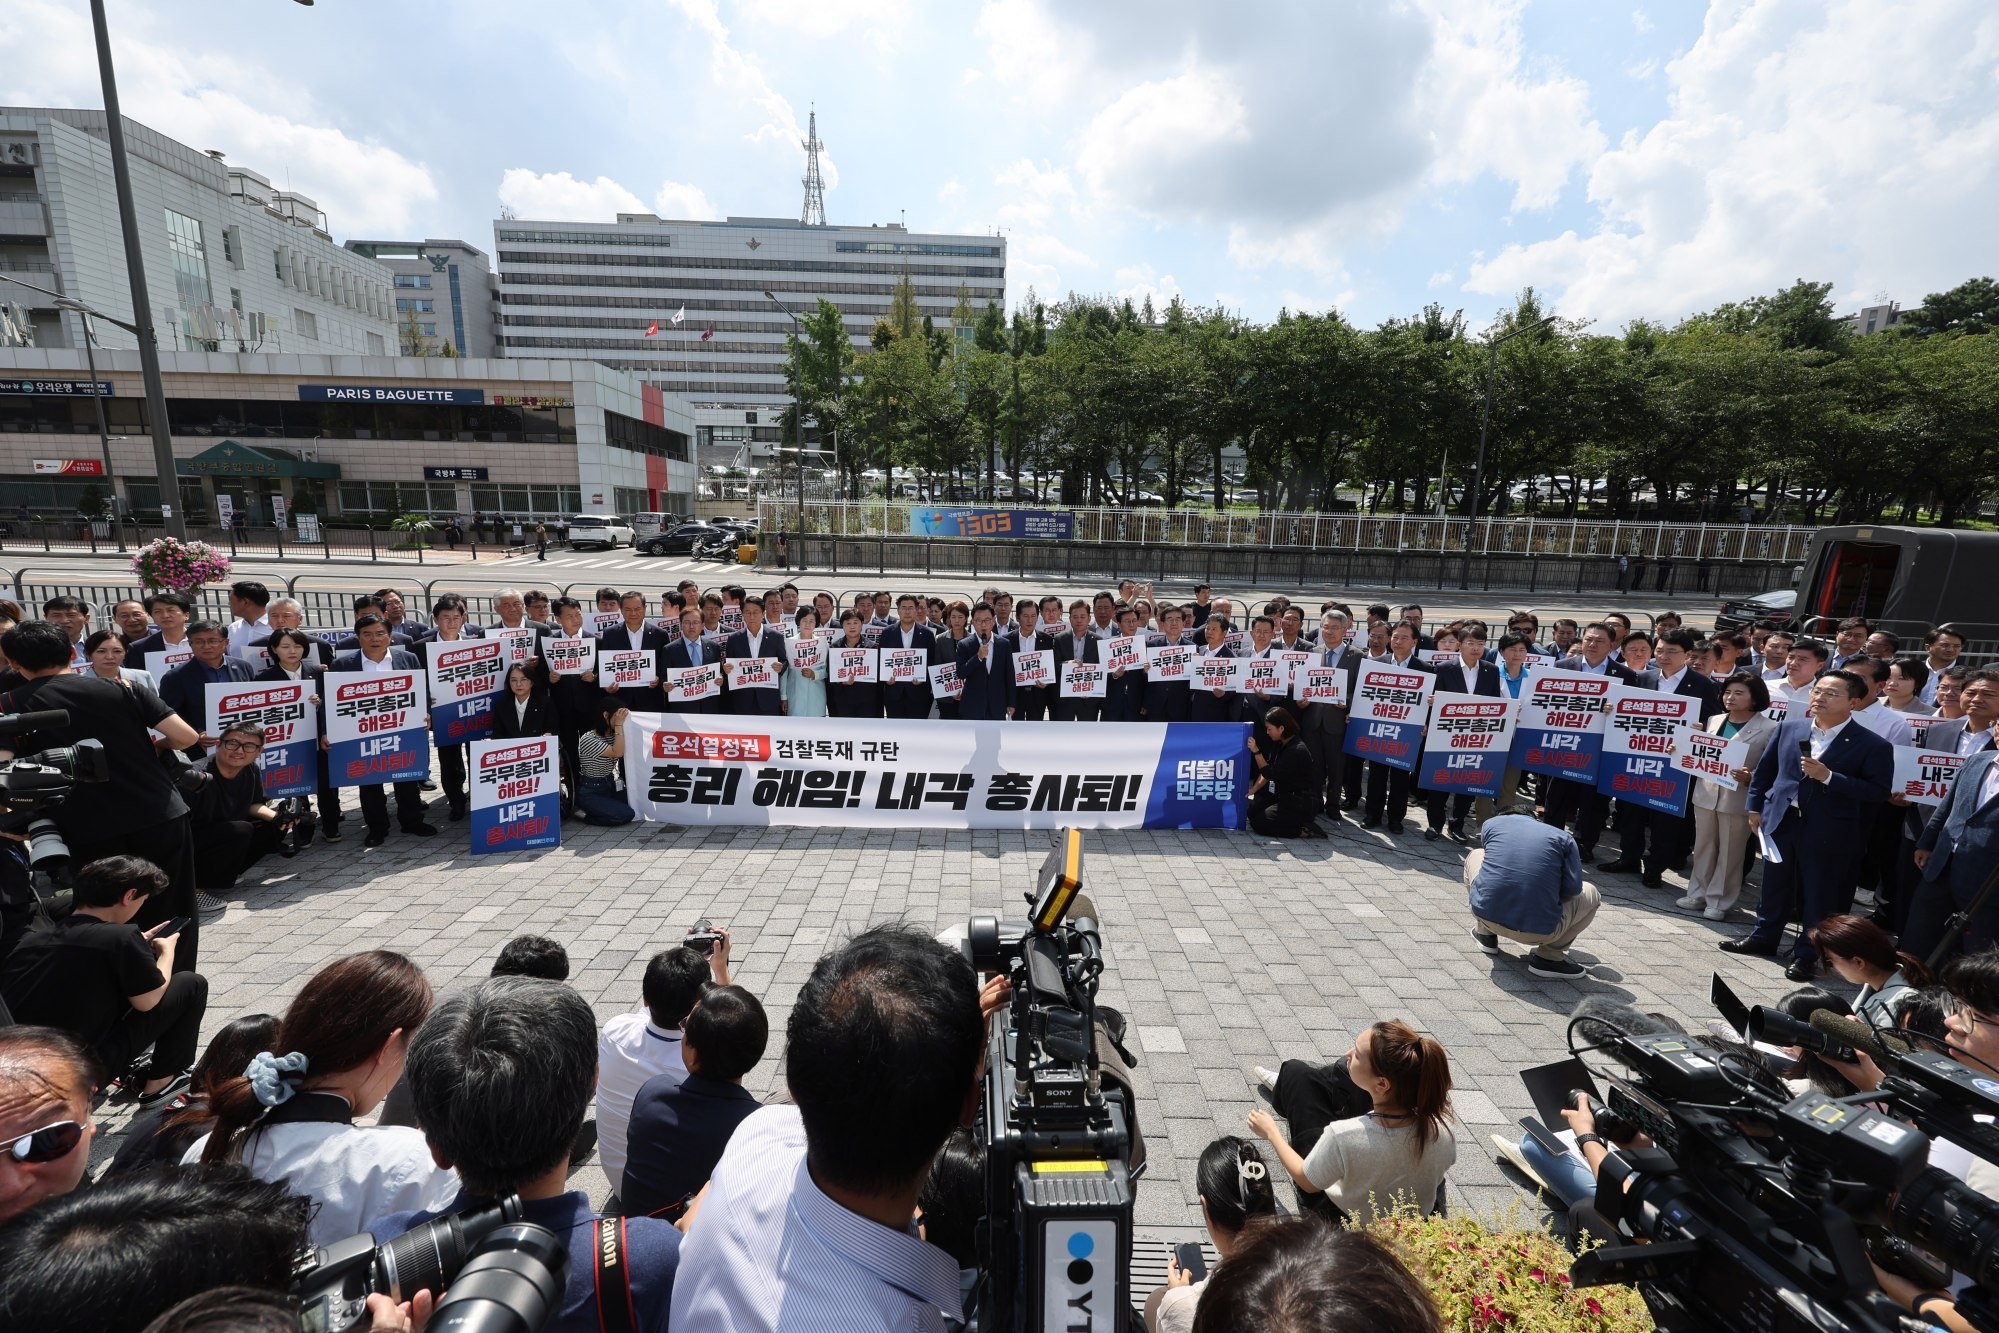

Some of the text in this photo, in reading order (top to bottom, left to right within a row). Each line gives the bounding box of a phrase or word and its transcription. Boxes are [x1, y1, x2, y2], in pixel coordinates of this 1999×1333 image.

[36, 382, 73, 393] 우리은행
[327, 389, 453, 400] PARIS BAGUETTE
[957, 513, 1011, 536] 1303
[476, 646, 495, 657] 정권
[546, 646, 590, 660] 국무총리
[798, 647, 817, 658] 내각
[1113, 645, 1132, 658] 내각
[554, 658, 581, 670] 해임!
[605, 658, 650, 672] 국무총리
[844, 657, 863, 667] 내각
[885, 656, 922, 668] 국무총리
[1022, 660, 1040, 671] 내각
[1108, 653, 1139, 669] 총사퇴!
[1153, 653, 1191, 668] 국무총리
[438, 657, 503, 682] 국무총리
[615, 670, 641, 682] 해임!
[742, 665, 763, 675] 내각
[838, 666, 869, 678] 총사퇴!
[893, 666, 914, 677] 해임!
[1016, 668, 1047, 682] 총사퇴!
[1161, 666, 1184, 676] 해임!
[1195, 665, 1236, 676] 국무총리
[1252, 668, 1274, 678] 내각
[674, 671, 715, 689] 국무총리
[737, 673, 770, 685] 총사퇴!
[1066, 671, 1102, 683] 국무총리
[1204, 676, 1227, 686] 해임!
[1245, 678, 1279, 689] 총사퇴!
[1310, 677, 1332, 687] 내각
[1399, 676, 1418, 686] 정권
[383, 679, 406, 690] 정권
[456, 675, 495, 696] 해임!
[684, 684, 707, 697] 해임!
[1073, 682, 1094, 692] 해임!
[1578, 682, 1601, 692] 정권
[269, 689, 295, 702] 정권
[1302, 687, 1338, 697] 총사퇴!
[1361, 686, 1423, 705] 국무총리
[336, 692, 415, 717] 국무총리
[458, 697, 492, 718] 내각
[1480, 705, 1500, 714] 정권
[1531, 694, 1607, 713] 국무총리
[1657, 703, 1680, 714] 정권
[1373, 703, 1411, 720] 해임!
[358, 711, 406, 733] 해임!
[1437, 718, 1506, 732] 국무총리
[1546, 711, 1593, 728] 해임!
[264, 723, 294, 743] 임!
[1368, 723, 1401, 740] 내각
[360, 735, 401, 757] 내각
[1356, 737, 1410, 756] 총사퇴!
[1451, 734, 1493, 748] 해임!
[1541, 733, 1581, 750] 내각
[520, 745, 540, 757] 정권
[776, 740, 854, 760] 검찰독재
[860, 741, 899, 761] 규탄
[1692, 744, 1722, 761] 내각
[347, 750, 416, 778] 총사퇴!
[1447, 755, 1483, 768] 내각
[1525, 749, 1592, 768] 총사퇴!
[480, 758, 549, 783] 국무총리
[1176, 760, 1234, 780] 더불어
[1626, 757, 1664, 777] 내각
[1681, 755, 1729, 777] 총사퇴!
[262, 765, 304, 788] 사퇴!
[1433, 769, 1493, 784] 총사퇴!
[498, 777, 540, 799] 해임!
[648, 764, 1143, 812] 총리 해임! 내각 총사퇴!
[1176, 780, 1235, 800] 민주당
[1612, 774, 1677, 797] 총사퇴!
[1905, 781, 1948, 798] 총사
[499, 801, 535, 823] 내각
[487, 816, 549, 845] 총사퇴!
[602, 1218, 616, 1268] Canon
